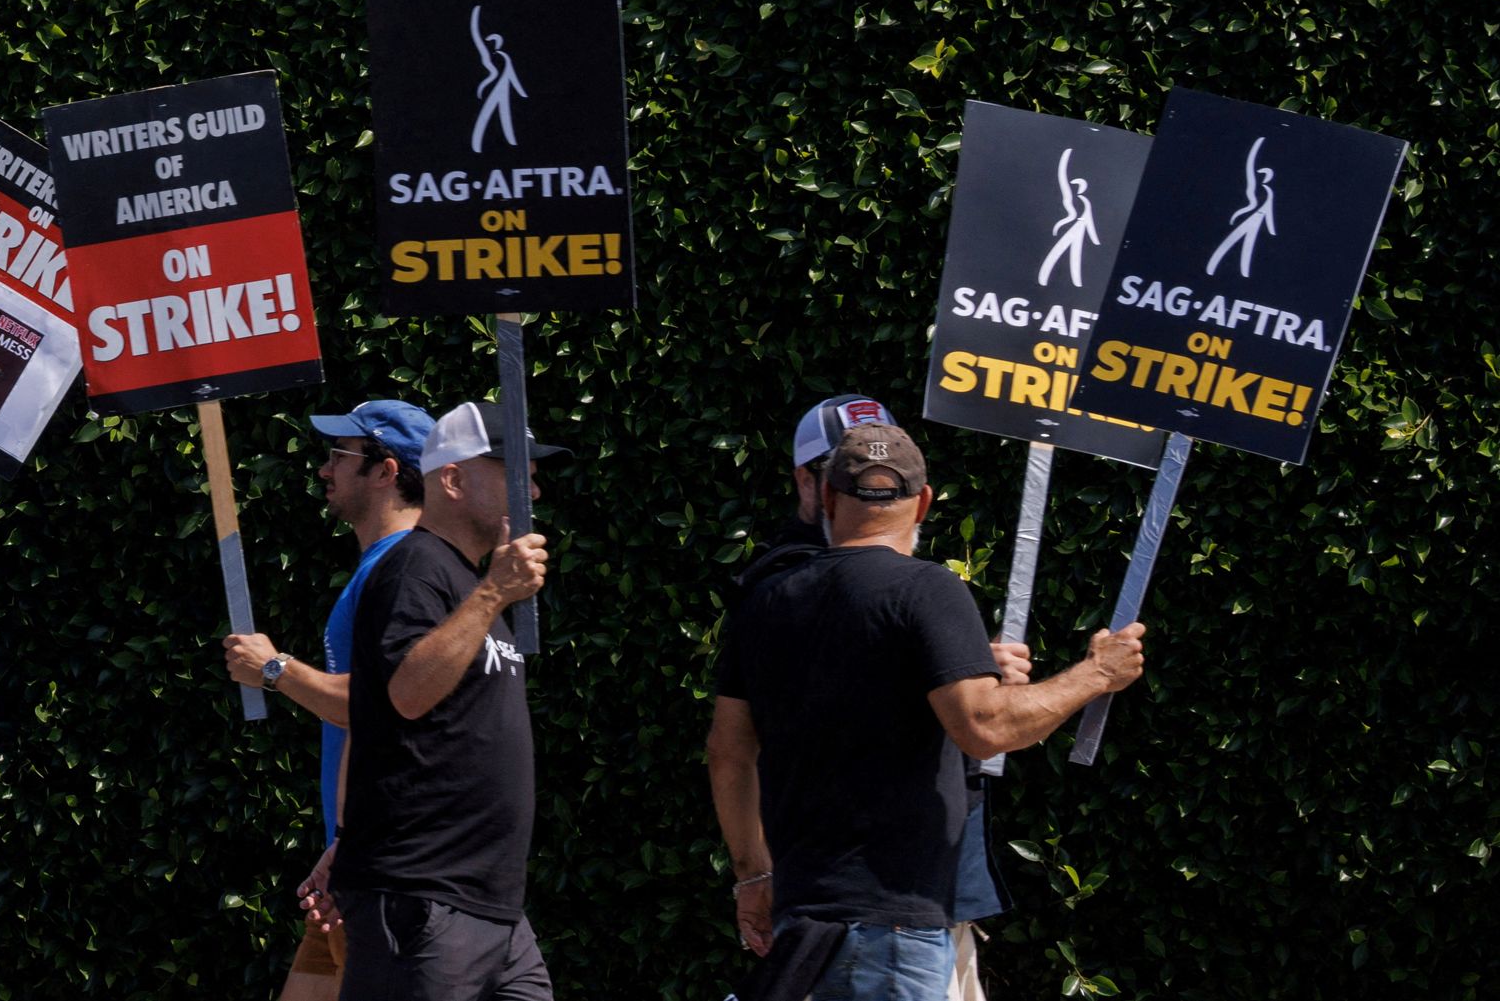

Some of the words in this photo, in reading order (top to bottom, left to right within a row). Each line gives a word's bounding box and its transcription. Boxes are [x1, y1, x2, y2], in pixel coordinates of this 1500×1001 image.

[61, 117, 185, 161] WRITERS
[188, 104, 266, 141] GUILD
[155, 155, 184, 180] OF
[28, 205, 55, 230] ON
[116, 180, 238, 225] AMERICA
[480, 209, 527, 232] ON
[162, 244, 212, 283] ON
[390, 233, 623, 283] STRIKE!
[88, 273, 301, 362] STRIKE!
[1033, 341, 1079, 369] ON
[1187, 332, 1233, 360] ON
[1090, 340, 1314, 427] STRIKE!
